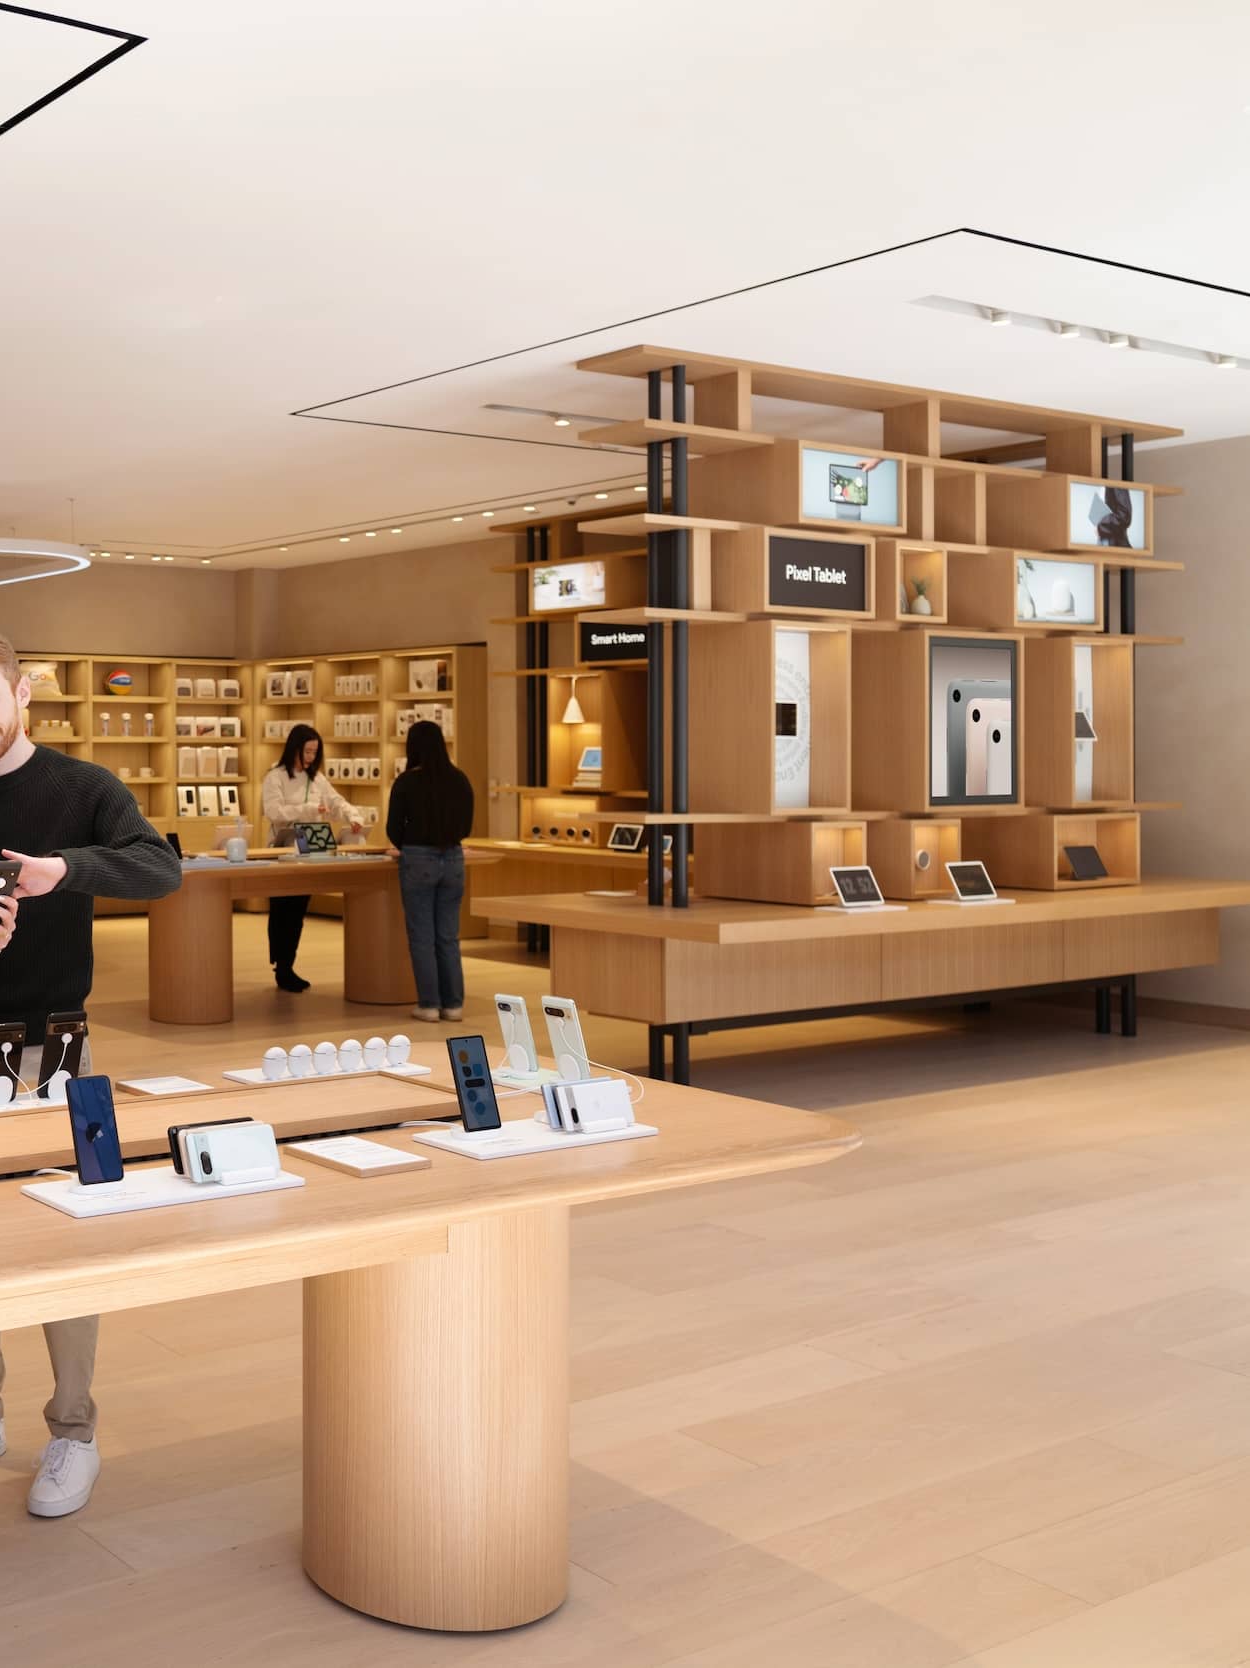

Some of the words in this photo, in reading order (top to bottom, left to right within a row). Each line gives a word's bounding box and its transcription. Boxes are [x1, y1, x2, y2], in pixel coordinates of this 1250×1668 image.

[786, 564, 812, 581] Pixel
[813, 566, 847, 584] Tablet
[591, 633, 617, 645] Smart
[618, 632, 645, 643] Home
